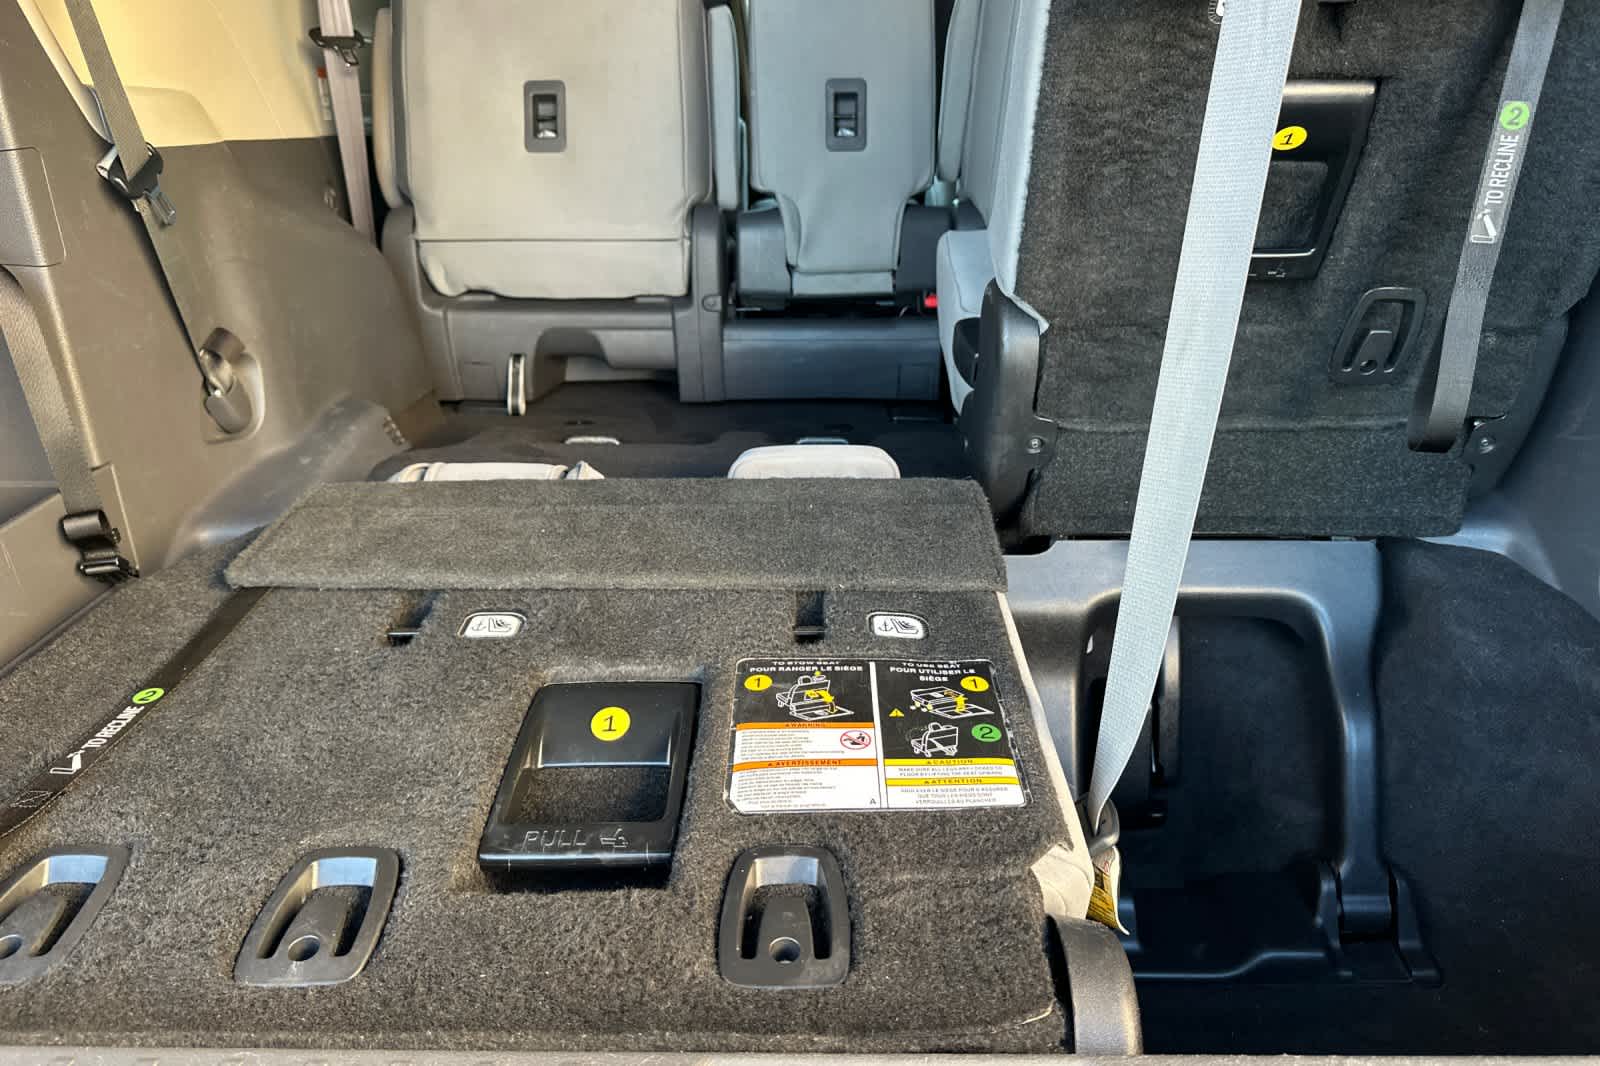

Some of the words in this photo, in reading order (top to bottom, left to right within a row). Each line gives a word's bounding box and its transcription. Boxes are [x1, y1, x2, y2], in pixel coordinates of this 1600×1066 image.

[1506, 105, 1523, 126] 2
[1488, 134, 1520, 187] RECLINE
[1484, 190, 1504, 206] TO
[80, 738, 108, 749] TO
[94, 705, 145, 738] RECLINE
[137, 690, 158, 702] 2
[979, 726, 997, 739] 2
[776, 759, 841, 767] AVERTISSEMENT
[521, 830, 587, 849] PULL
